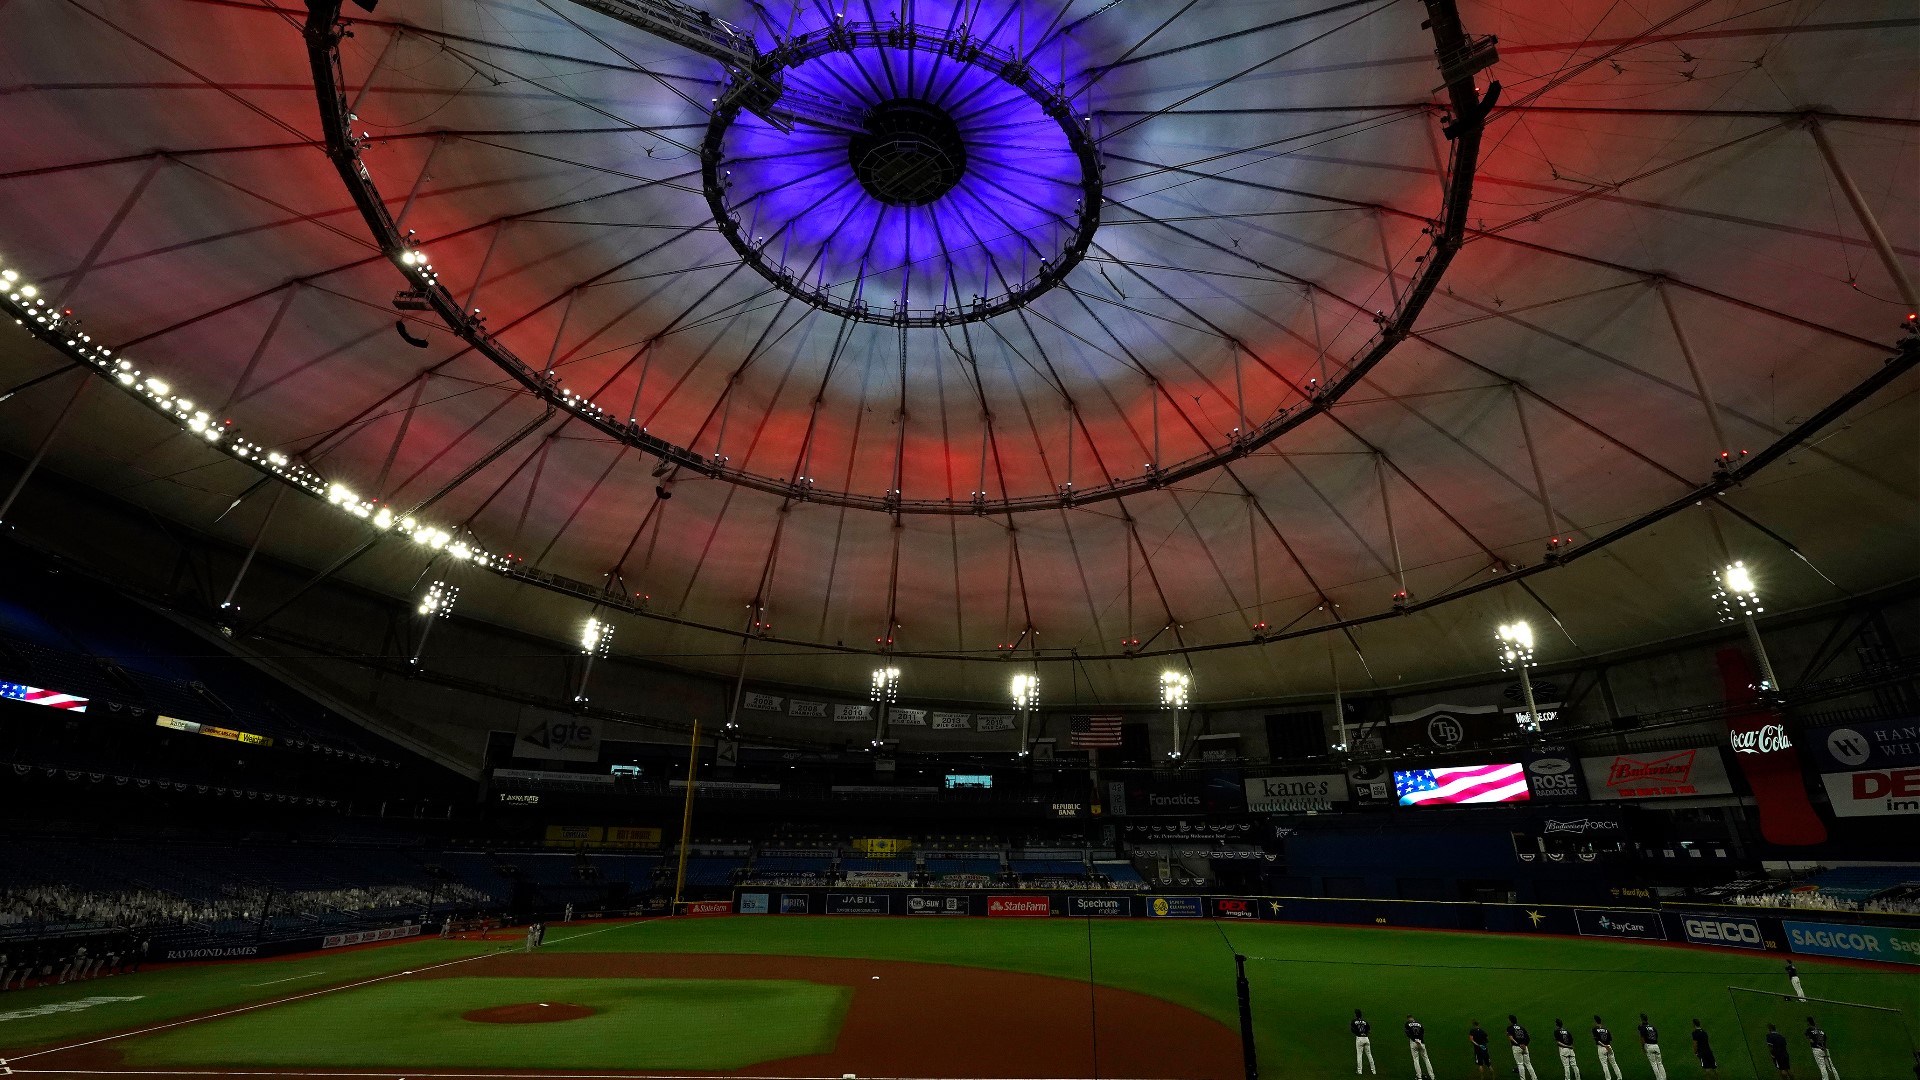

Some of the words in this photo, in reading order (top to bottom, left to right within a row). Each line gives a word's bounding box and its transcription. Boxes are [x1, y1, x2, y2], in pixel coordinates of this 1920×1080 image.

[746, 703, 778, 711] CHAMPIONS
[753, 697, 773, 706] 2008
[790, 709, 823, 717] CHAMPIONS
[797, 704, 818, 712] 2008
[843, 708, 863, 716] 2010
[897, 713, 917, 721] 2011
[941, 716, 961, 724] 2013
[551, 721, 593, 744] gte
[1434, 720, 1459, 743] TB
[1873, 726, 1920, 742] HAN
[1730, 723, 1792, 754] Coca-Cola
[1611, 763, 1691, 779] Budweiser
[1532, 773, 1577, 789] ROSE
[1263, 779, 1329, 797] kanes
[1535, 787, 1578, 798] RADIOLOGY
[1149, 793, 1201, 806] Fanatics
[1548, 820, 1587, 831] Budweiser
[1586, 820, 1619, 830] PORCH
[1622, 887, 1636, 897] Hard
[1635, 887, 1650, 899] Rock
[842, 896, 875, 904] JABIL
[1077, 898, 1119, 909] Spectrum
[1218, 899, 1249, 911] DEX
[1098, 907, 1117, 915] mobile
[1685, 919, 1760, 944] GEICO
[1791, 928, 1882, 953] SAGICOR
[167, 948, 222, 960] RAYMOND
[222, 946, 258, 957] JAMES
